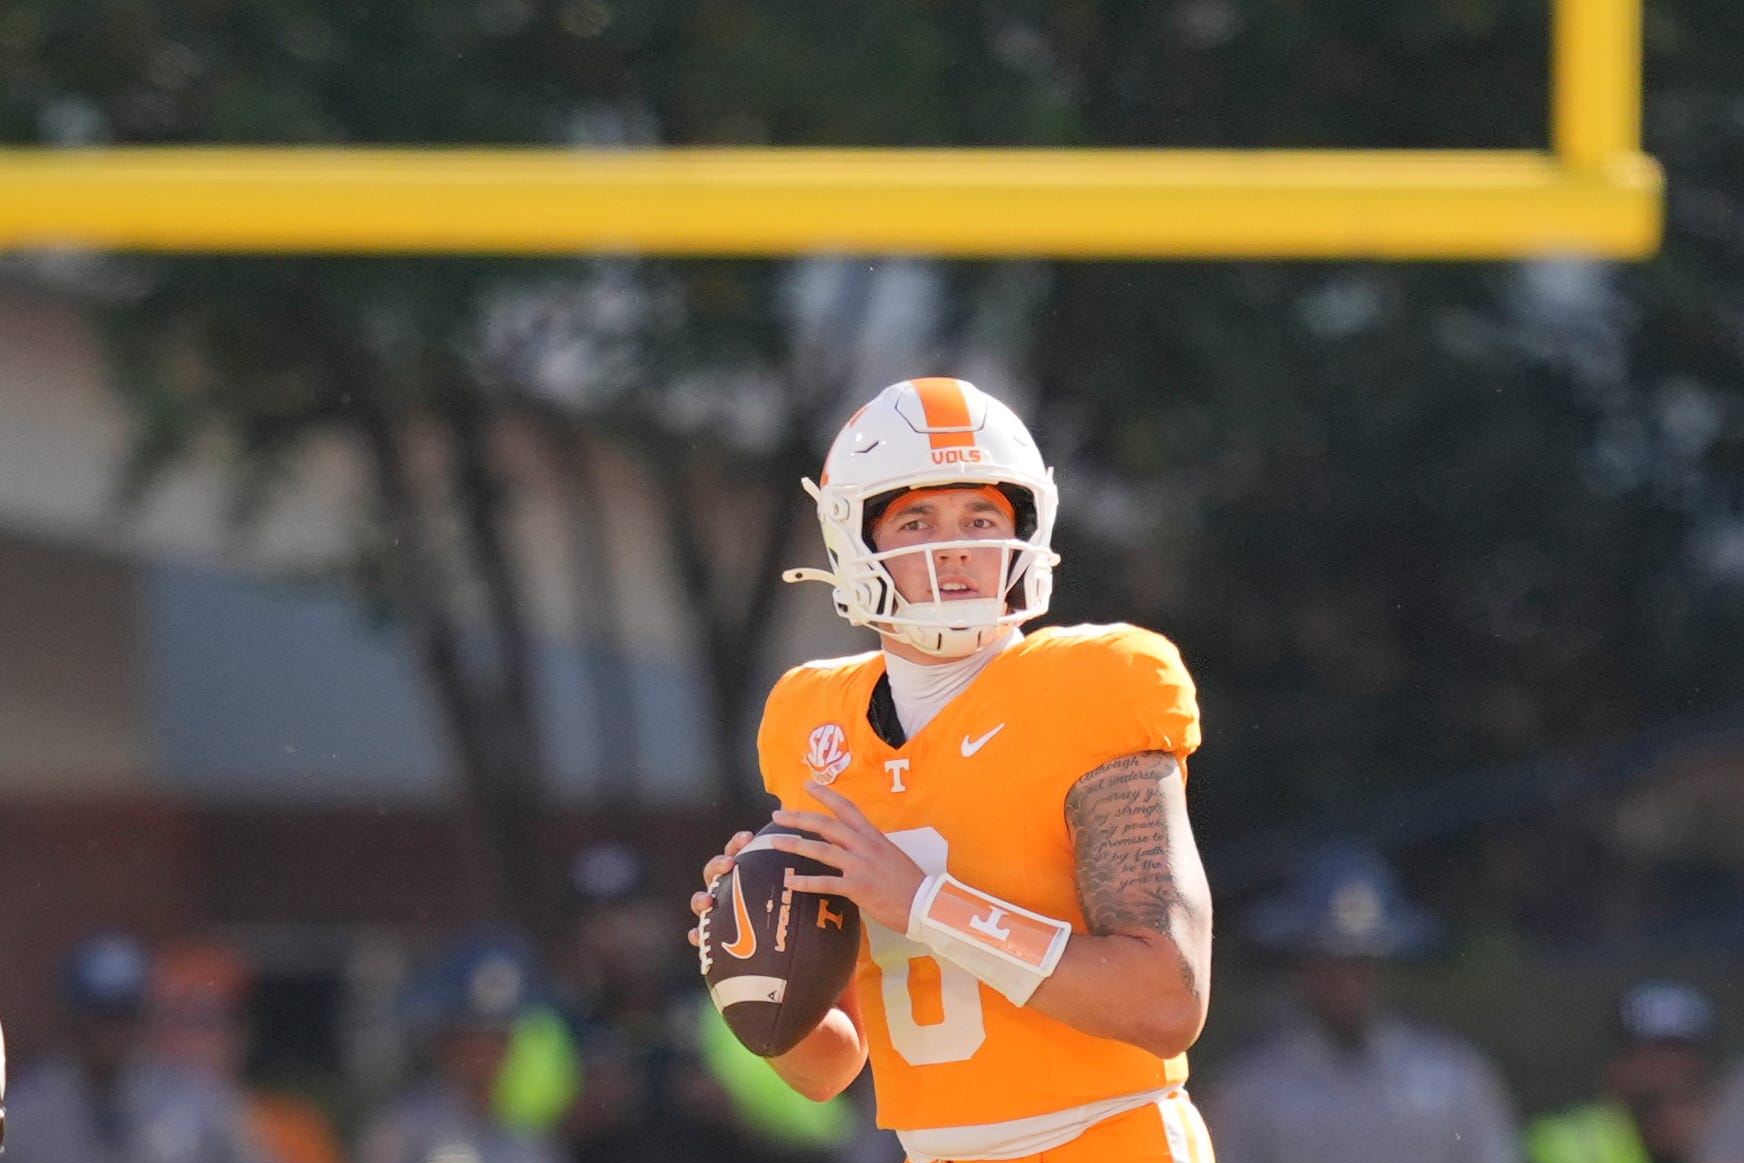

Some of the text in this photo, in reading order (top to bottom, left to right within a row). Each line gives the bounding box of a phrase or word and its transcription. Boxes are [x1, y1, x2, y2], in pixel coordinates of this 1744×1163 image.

[931, 450, 982, 464] VOLS
[884, 758, 910, 793] T
[816, 898, 844, 931] T
[968, 903, 1011, 942] T
